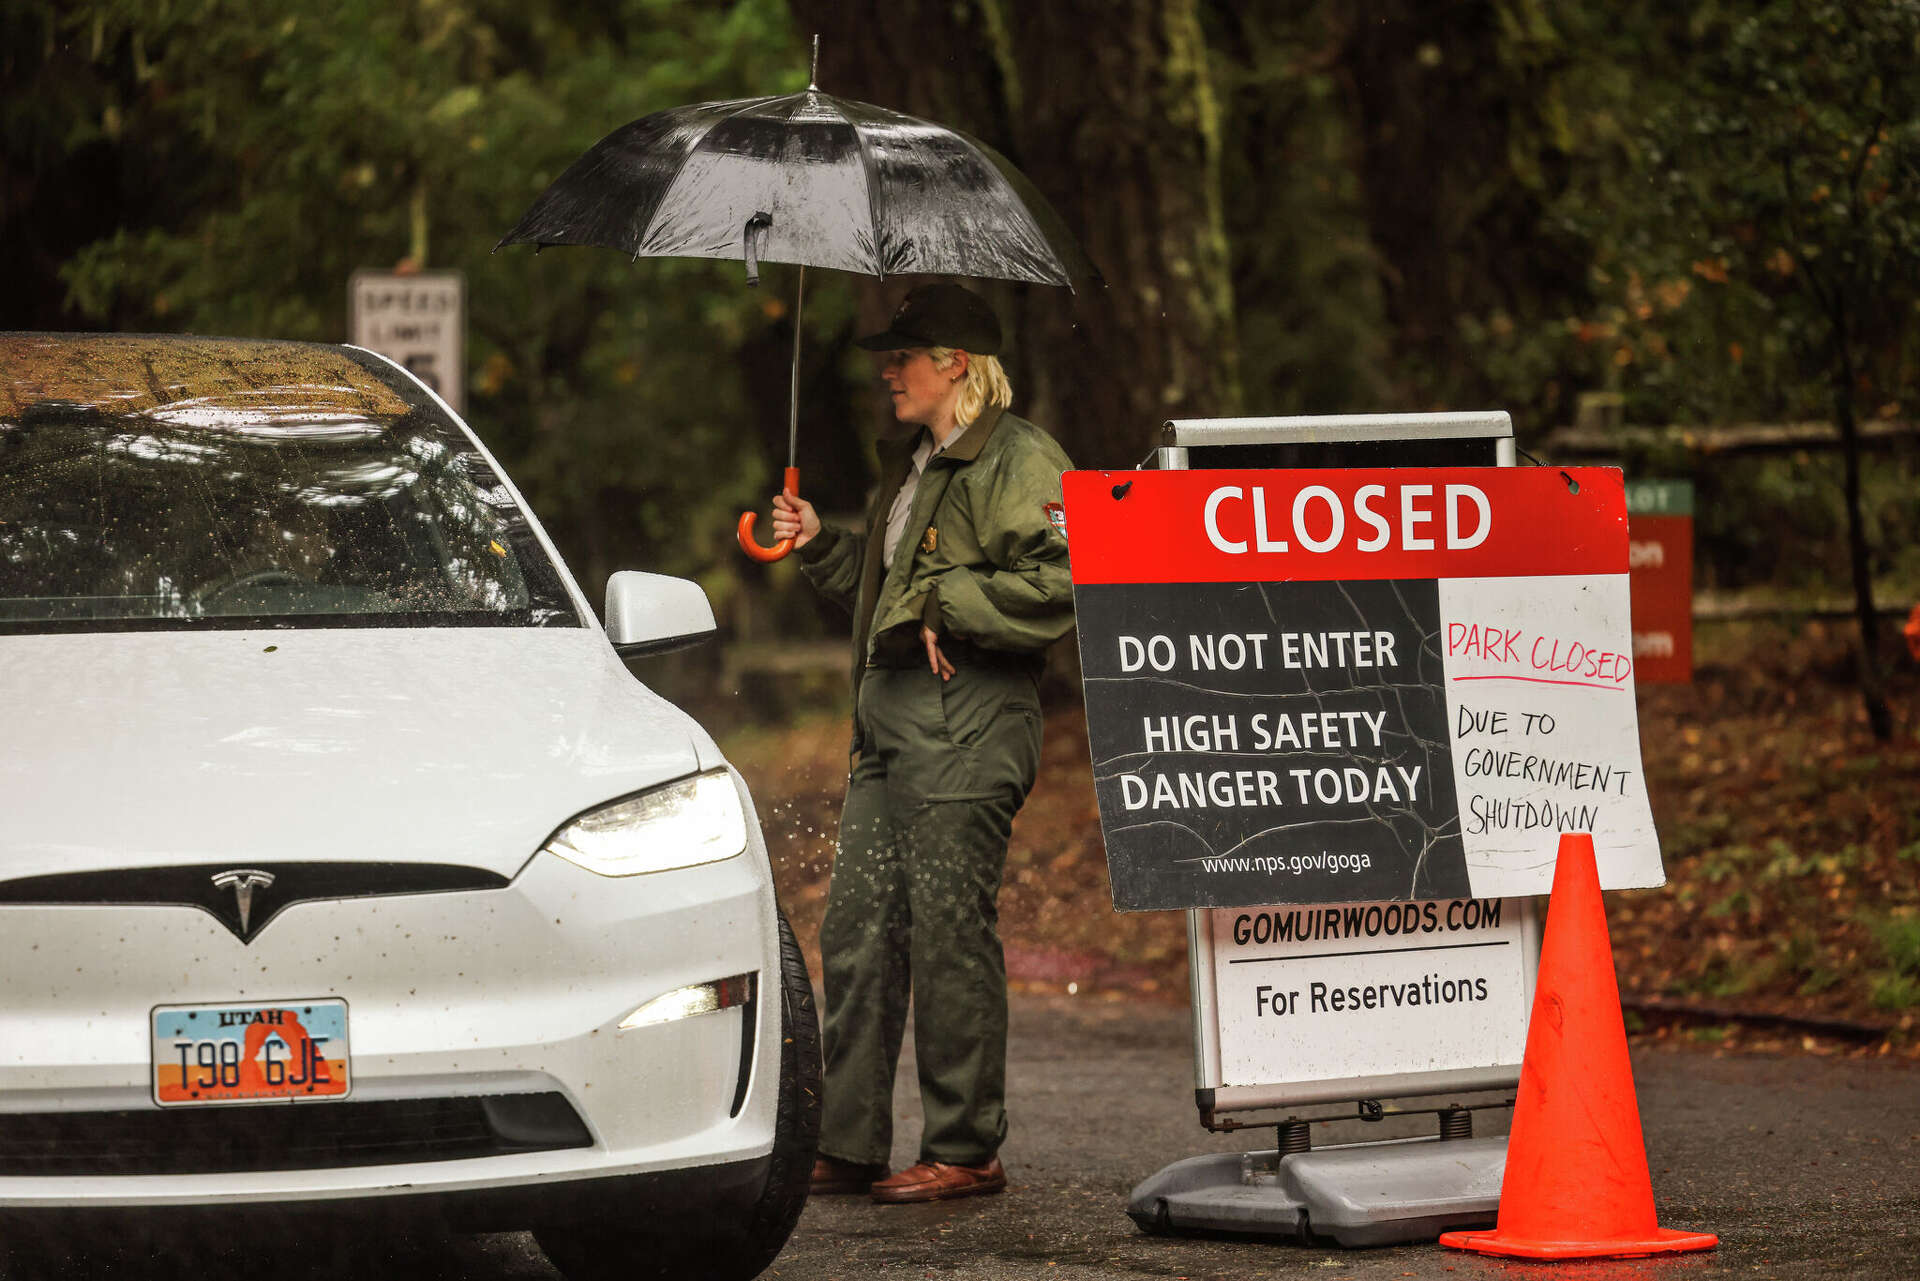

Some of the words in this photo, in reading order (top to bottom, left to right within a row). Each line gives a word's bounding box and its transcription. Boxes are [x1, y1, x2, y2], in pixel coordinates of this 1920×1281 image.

[1203, 483, 1492, 554] CLOSED
[1118, 634, 1177, 672] DO
[1189, 633, 1269, 671] NOT
[1281, 631, 1398, 669] ENTER
[1448, 622, 1522, 663] PARK
[1531, 636, 1632, 683] CLOSED
[1143, 714, 1239, 752] HIGH
[1251, 711, 1387, 750] SAFETY
[1457, 704, 1508, 739] DUE
[1521, 712, 1555, 735] TO
[1120, 770, 1283, 811] DANGER
[1289, 765, 1422, 806] TODAY
[1464, 748, 1633, 796] GOVERNMENT
[1466, 794, 1599, 835] SHUTDOWN
[1202, 850, 1372, 876] www.nps.gov/goga
[1233, 898, 1502, 946] GOMUIRWOODS.COM
[1256, 986, 1299, 1017] For
[1310, 973, 1488, 1013] Reservations
[218, 1010, 284, 1028] UTAH
[174, 1041, 240, 1090] T98
[265, 1037, 331, 1085] 6JE
